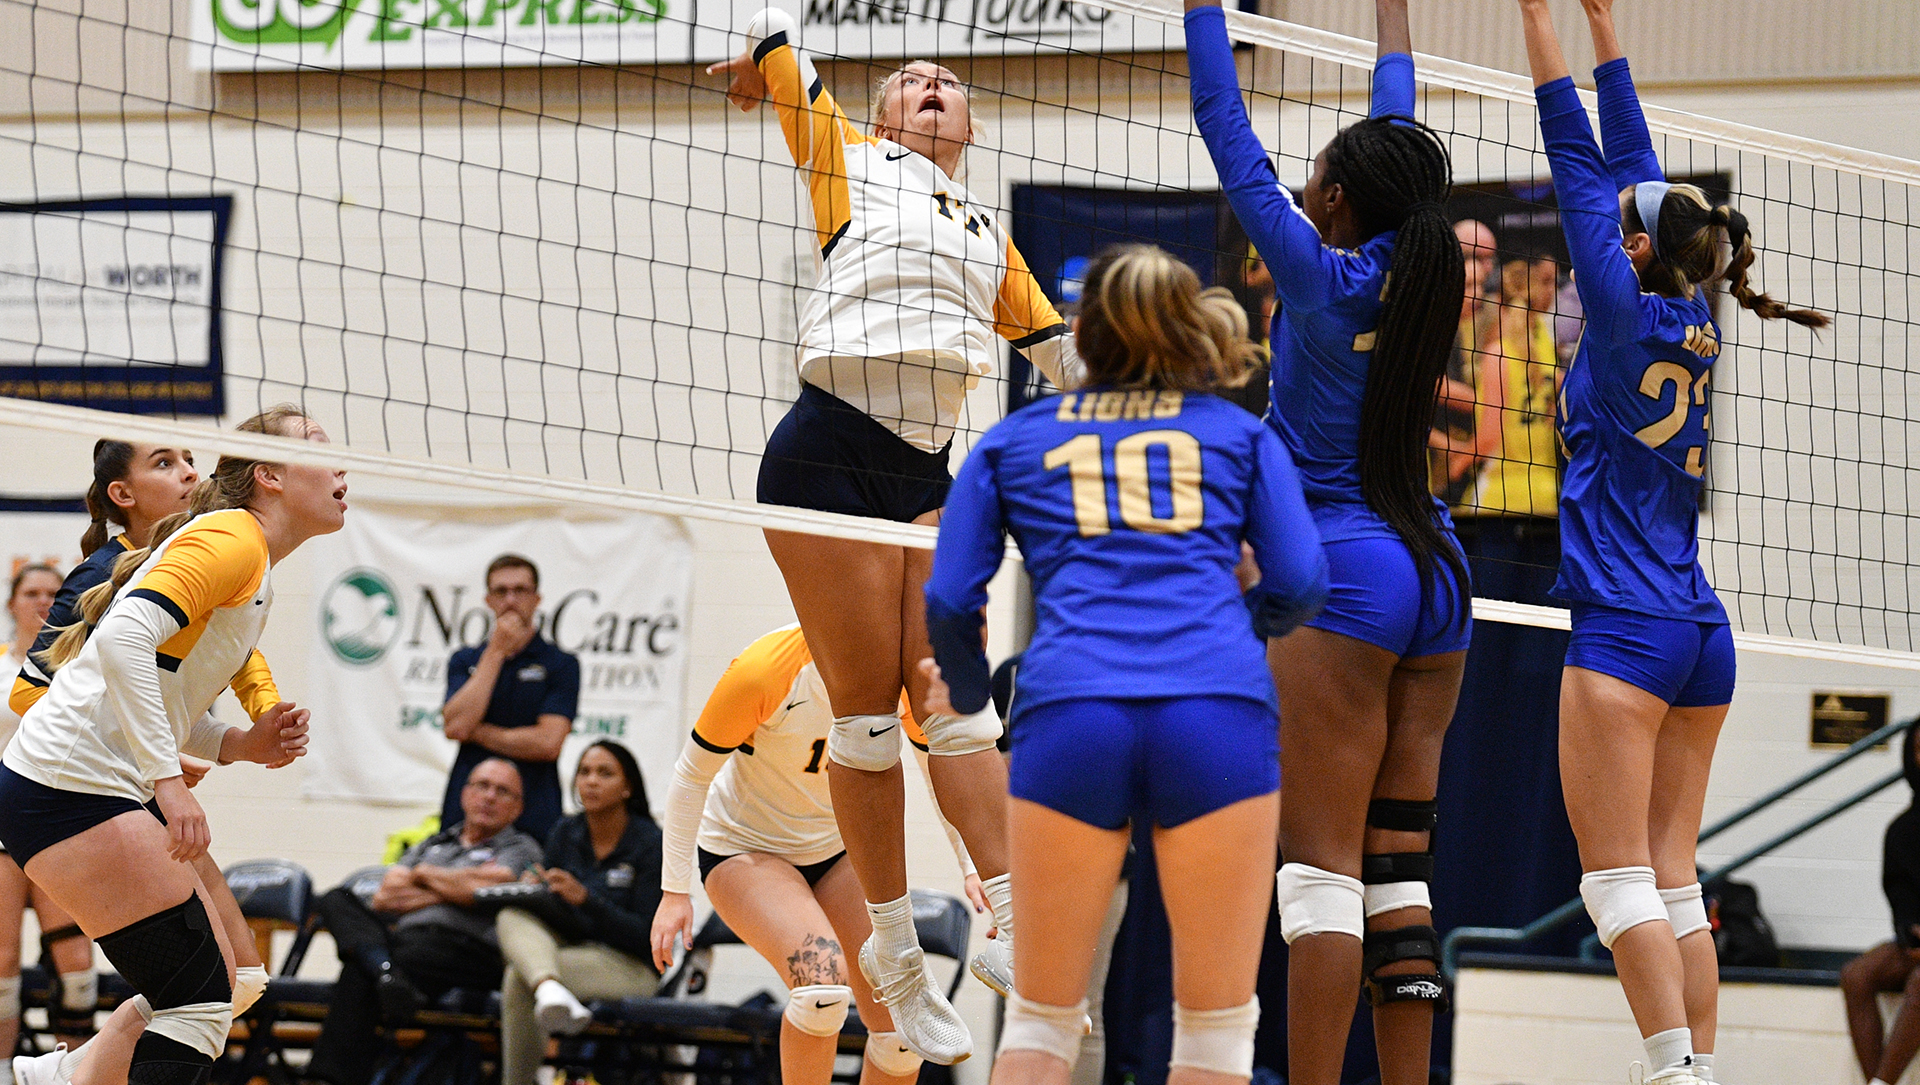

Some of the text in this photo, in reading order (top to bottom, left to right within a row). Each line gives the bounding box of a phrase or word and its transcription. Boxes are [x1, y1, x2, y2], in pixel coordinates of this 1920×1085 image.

[1056, 389, 1185, 422] LIONS
[1043, 428, 1204, 538] 10
[408, 584, 680, 656] NoCare
[803, 738, 829, 774] 1
